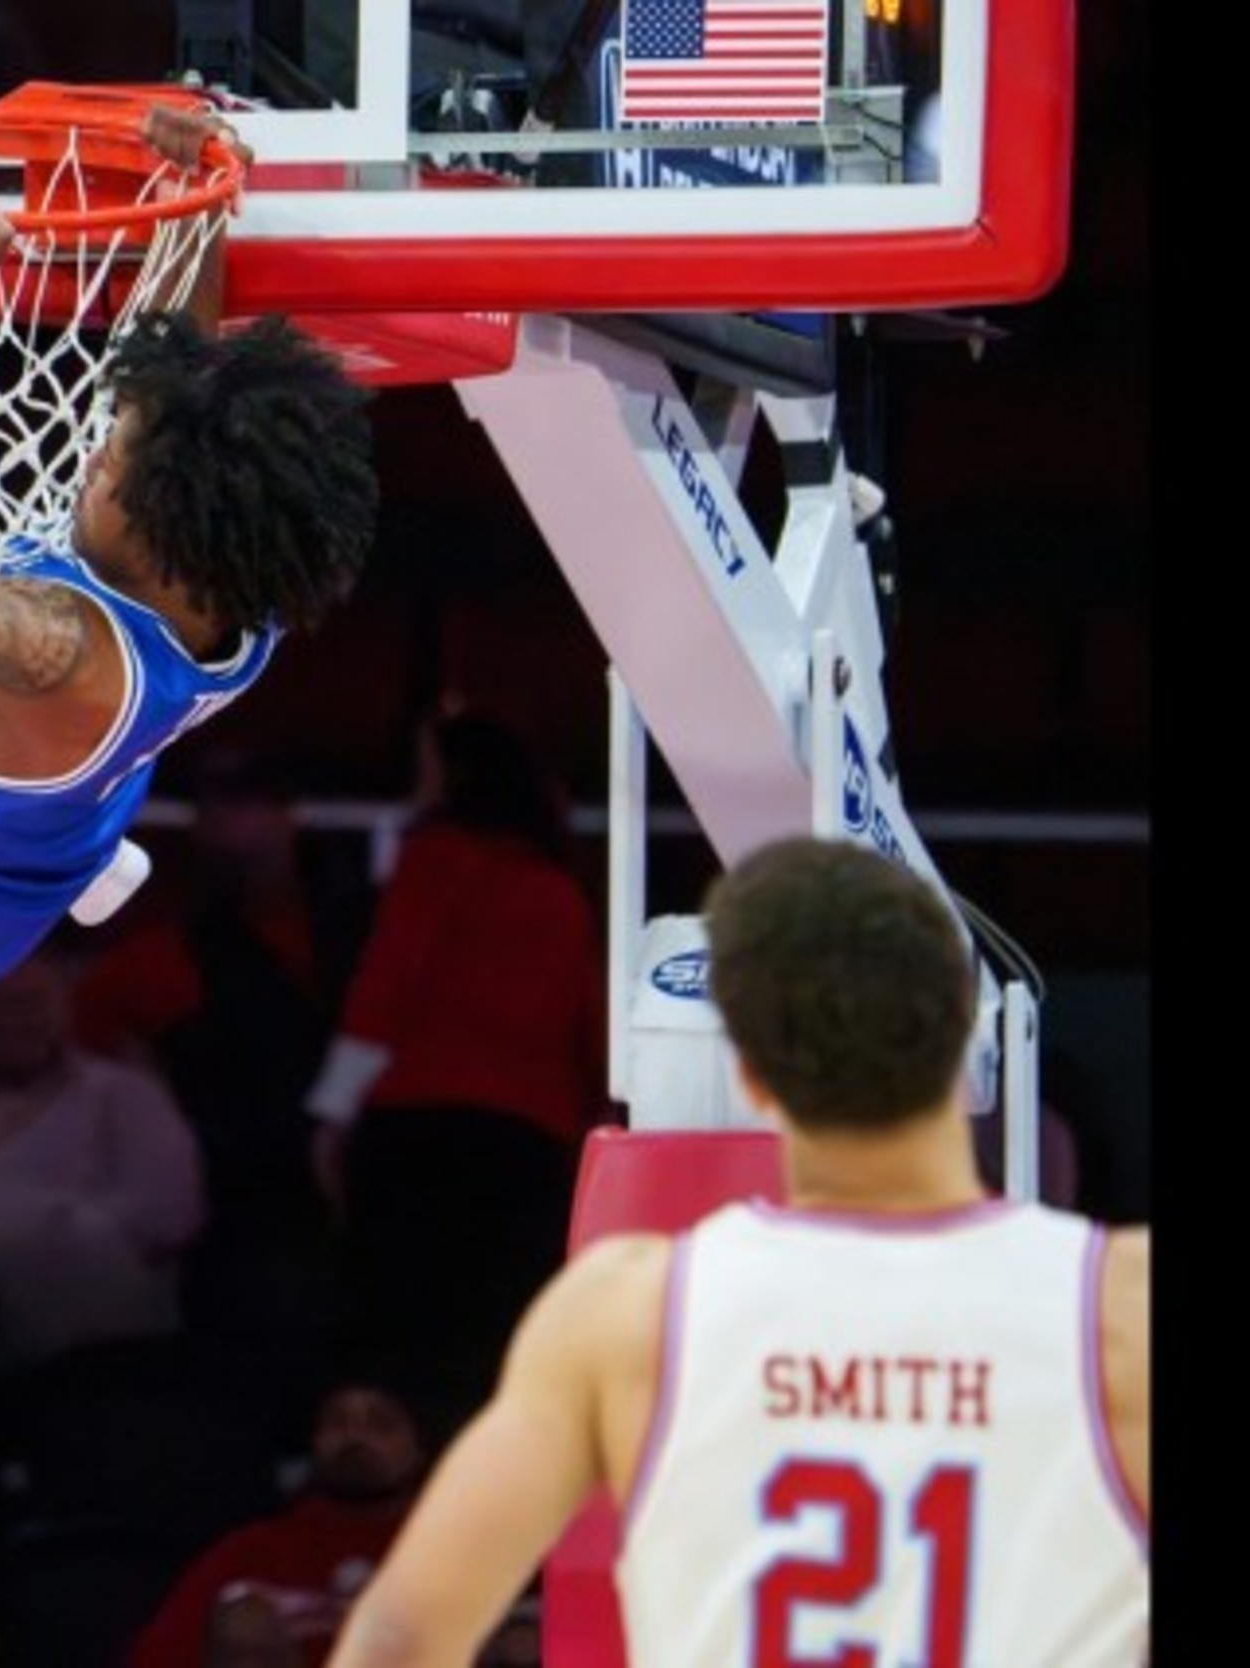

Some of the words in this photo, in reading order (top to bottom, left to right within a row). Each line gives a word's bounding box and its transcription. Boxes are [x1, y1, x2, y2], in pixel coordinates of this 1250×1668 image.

[652, 391, 746, 578] LEGACY
[762, 1354, 990, 1426] SMITH
[748, 1455, 980, 1668] 21
